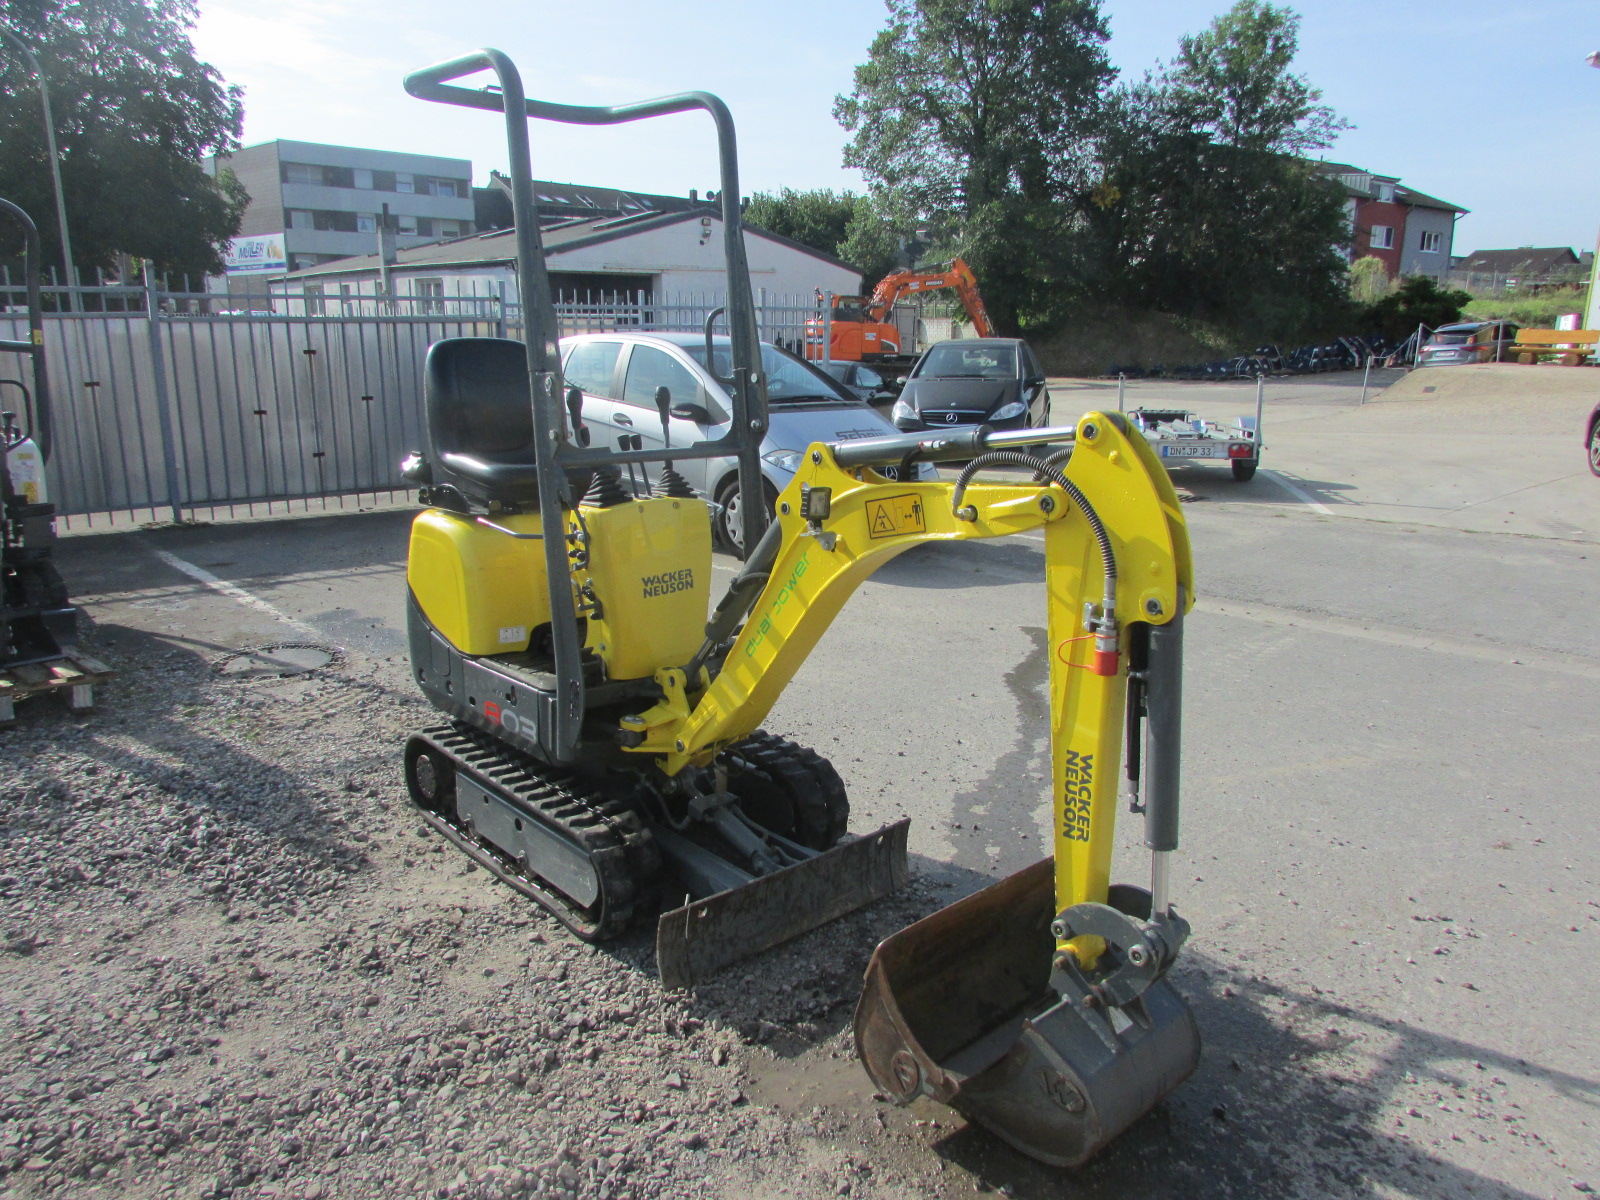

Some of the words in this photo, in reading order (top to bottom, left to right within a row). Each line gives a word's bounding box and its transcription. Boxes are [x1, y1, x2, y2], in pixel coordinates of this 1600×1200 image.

[1170, 447, 1181, 456] DN
[1187, 447, 1198, 456] JP
[1200, 447, 1211, 456] 33
[641, 568, 693, 587] WACKER
[643, 578, 693, 599] NEUSON
[484, 701, 537, 744] 803
[1062, 749, 1080, 840] NEUSON
[1076, 754, 1093, 842] WACKER
